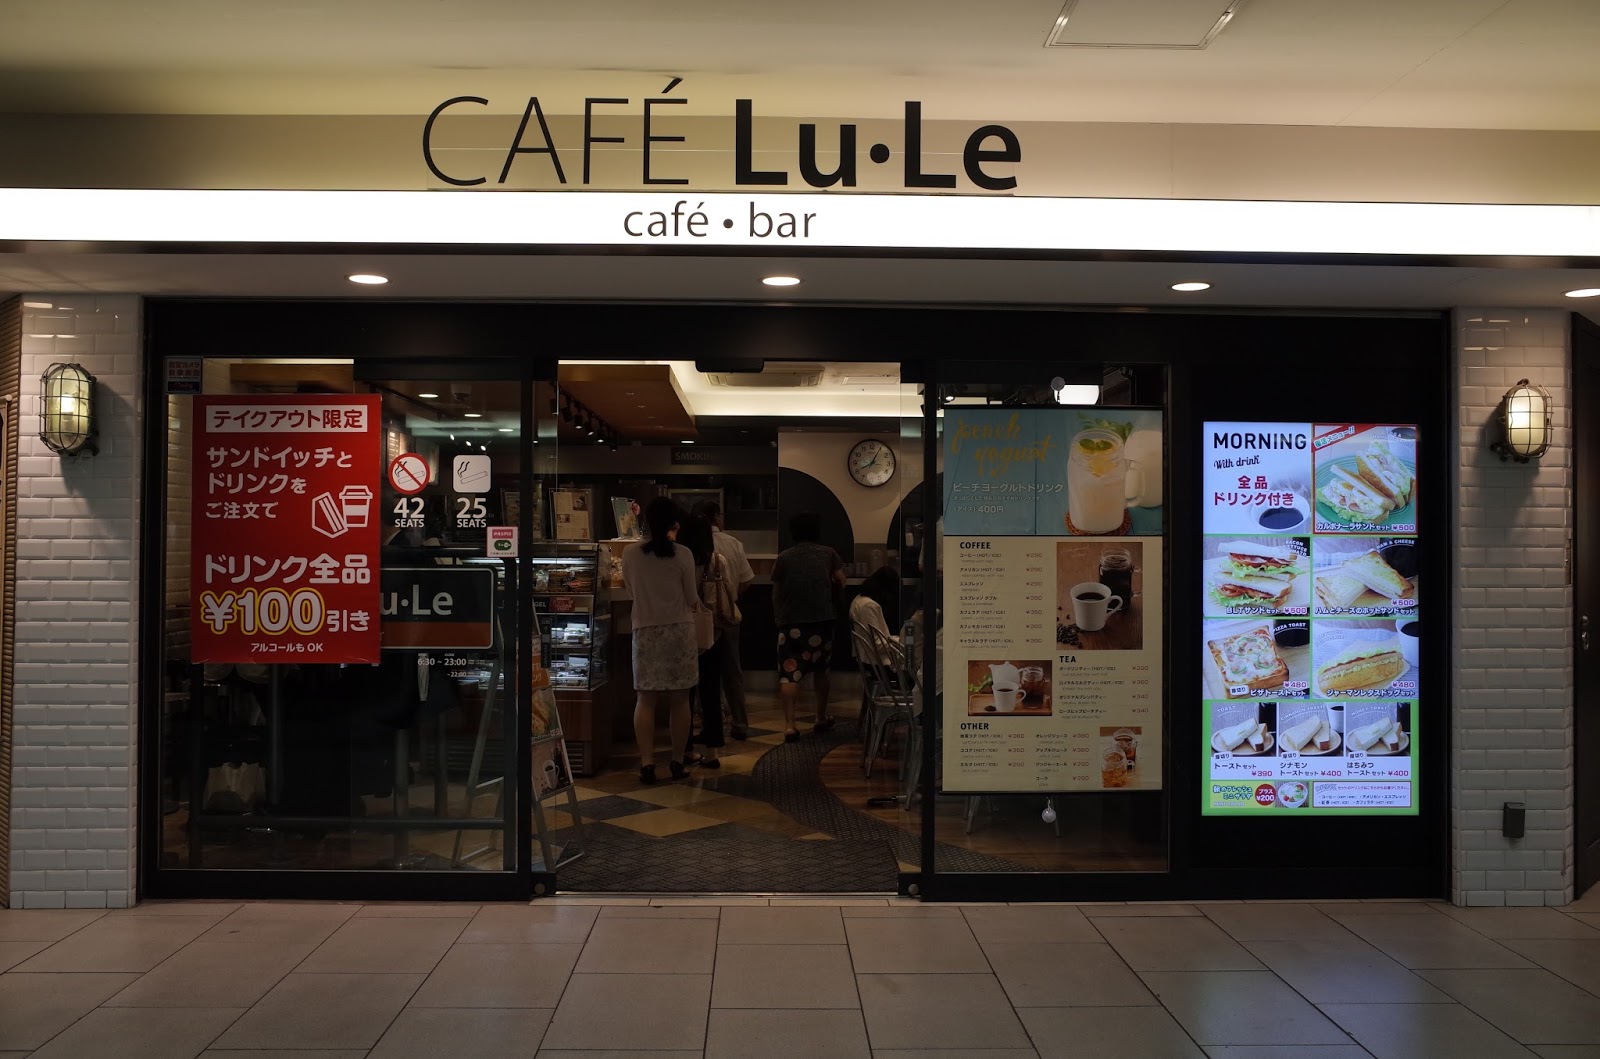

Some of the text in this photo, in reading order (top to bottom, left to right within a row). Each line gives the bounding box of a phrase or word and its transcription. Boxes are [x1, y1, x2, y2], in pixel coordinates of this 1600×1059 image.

[422, 78, 690, 187] CAFÉ
[623, 201, 817, 240] café bar
[213, 409, 363, 429] テイクアウト限定
[1213, 432, 1307, 450] MORNING
[206, 446, 352, 469] サンドイッチと
[675, 451, 714, 461] SMOKIN
[1214, 455, 1260, 470] With drink
[208, 473, 307, 494] ドリンクを
[953, 483, 1064, 493] ピーチヨーグルトドリンク
[1237, 475, 1268, 490] 全品
[1214, 492, 1294, 507] ドリンク付き
[205, 502, 279, 520] ご注文で
[393, 497, 425, 519] 42
[456, 497, 487, 519] 25
[977, 505, 1004, 513] 400円
[394, 518, 425, 528] SEATS
[456, 518, 487, 528] SEATS
[960, 541, 991, 550] COFFEE
[205, 553, 371, 584] ドリンク全品
[307, 643, 324, 652] OK
[417, 658, 436, 666] 6:30
[443, 658, 467, 666] 23:00
[1059, 655, 1077, 663] TEA
[960, 722, 989, 730] OTHER
